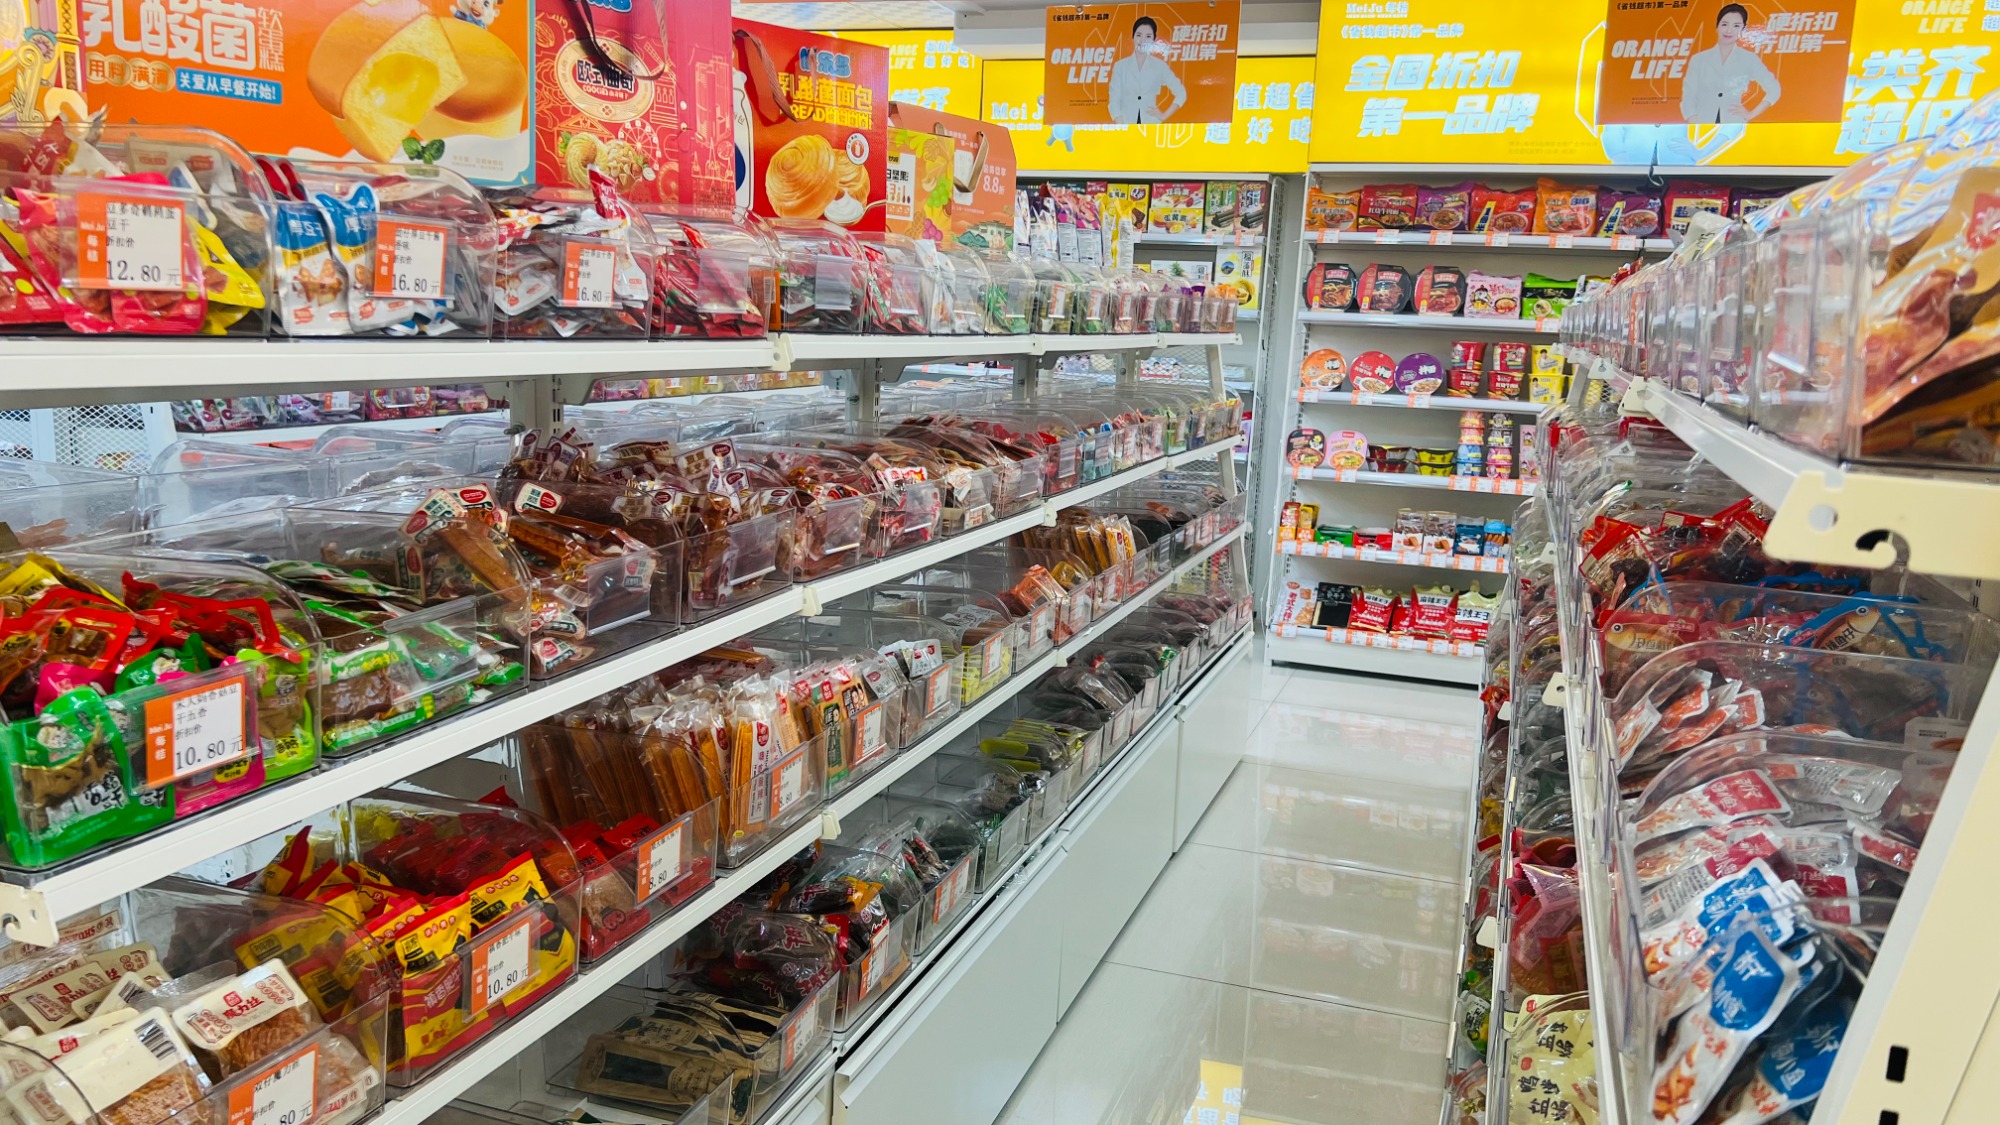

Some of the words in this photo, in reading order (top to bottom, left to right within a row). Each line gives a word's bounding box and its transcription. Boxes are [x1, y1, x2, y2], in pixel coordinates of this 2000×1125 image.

[1901, 0, 1973, 15] ORANGE
[1767, 12, 1838, 31] 硬折扣
[1918, 17, 1968, 34] LIFE
[82, 0, 256, 71] 乳酸菌
[258, 7, 284, 72] 软蛋糕
[1172, 24, 1228, 41] 硬折扣
[1341, 24, 1464, 39] 《省钱超市》第一品牌
[1164, 44, 1235, 61] 行业第一
[1611, 38, 1694, 58] ORANGE
[1753, 34, 1847, 53] 行业第一
[1051, 47, 1115, 64] ORANGE
[1067, 66, 1111, 83] LIFE
[1344, 50, 1522, 91] 全国折扣
[1630, 59, 1687, 79] LIFE
[778, 72, 872, 111] 乳酸菌面包
[780, 104, 825, 122] READ
[991, 102, 1027, 120] Mei
[1357, 94, 1540, 137] 第一品牌
[107, 260, 162, 281] 12.80
[167, 268, 181, 286] 元
[392, 274, 428, 293] 16.80
[576, 287, 602, 302] 16.80
[1420, 596, 1449, 606] 麻辣王子
[176, 740, 225, 770] 10.80
[231, 735, 243, 754] 元
[488, 969, 518, 999] 10.80
[223, 996, 265, 1020] 魔力丝
